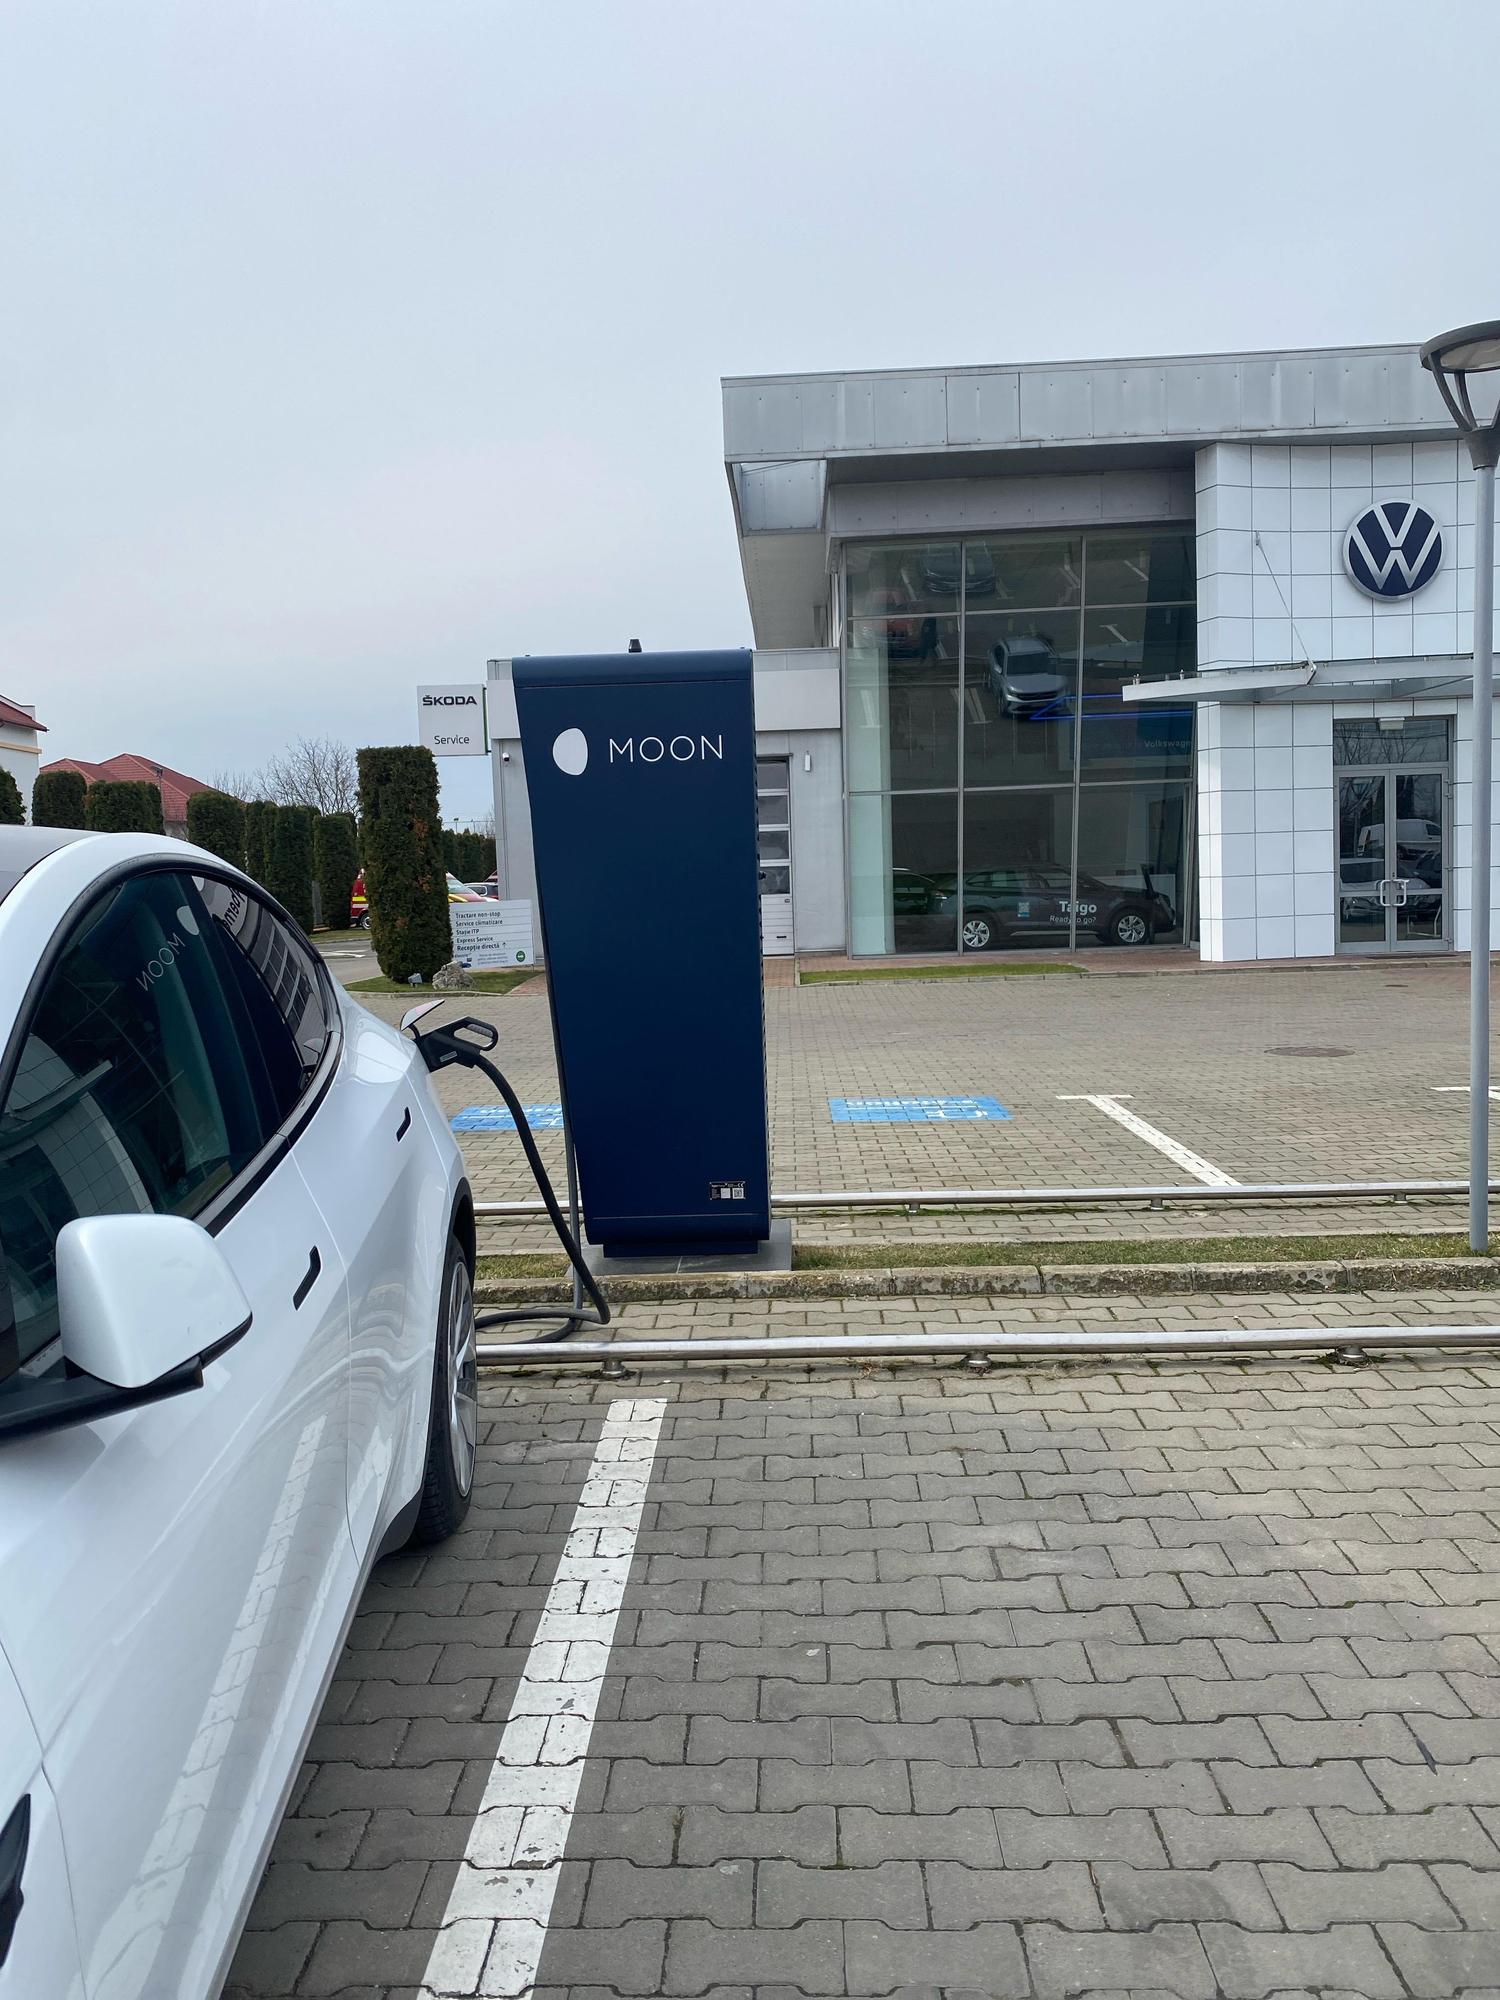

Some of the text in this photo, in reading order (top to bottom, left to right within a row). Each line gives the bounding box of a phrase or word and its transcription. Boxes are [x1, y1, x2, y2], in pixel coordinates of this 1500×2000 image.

[1346, 500, 1441, 594] VW
[423, 695, 477, 706] ŠKODA
[434, 735, 470, 745] Service
[609, 735, 723, 763] MOON
[1059, 901, 1097, 915] Taigo
[1083, 916, 1097, 925] go?
